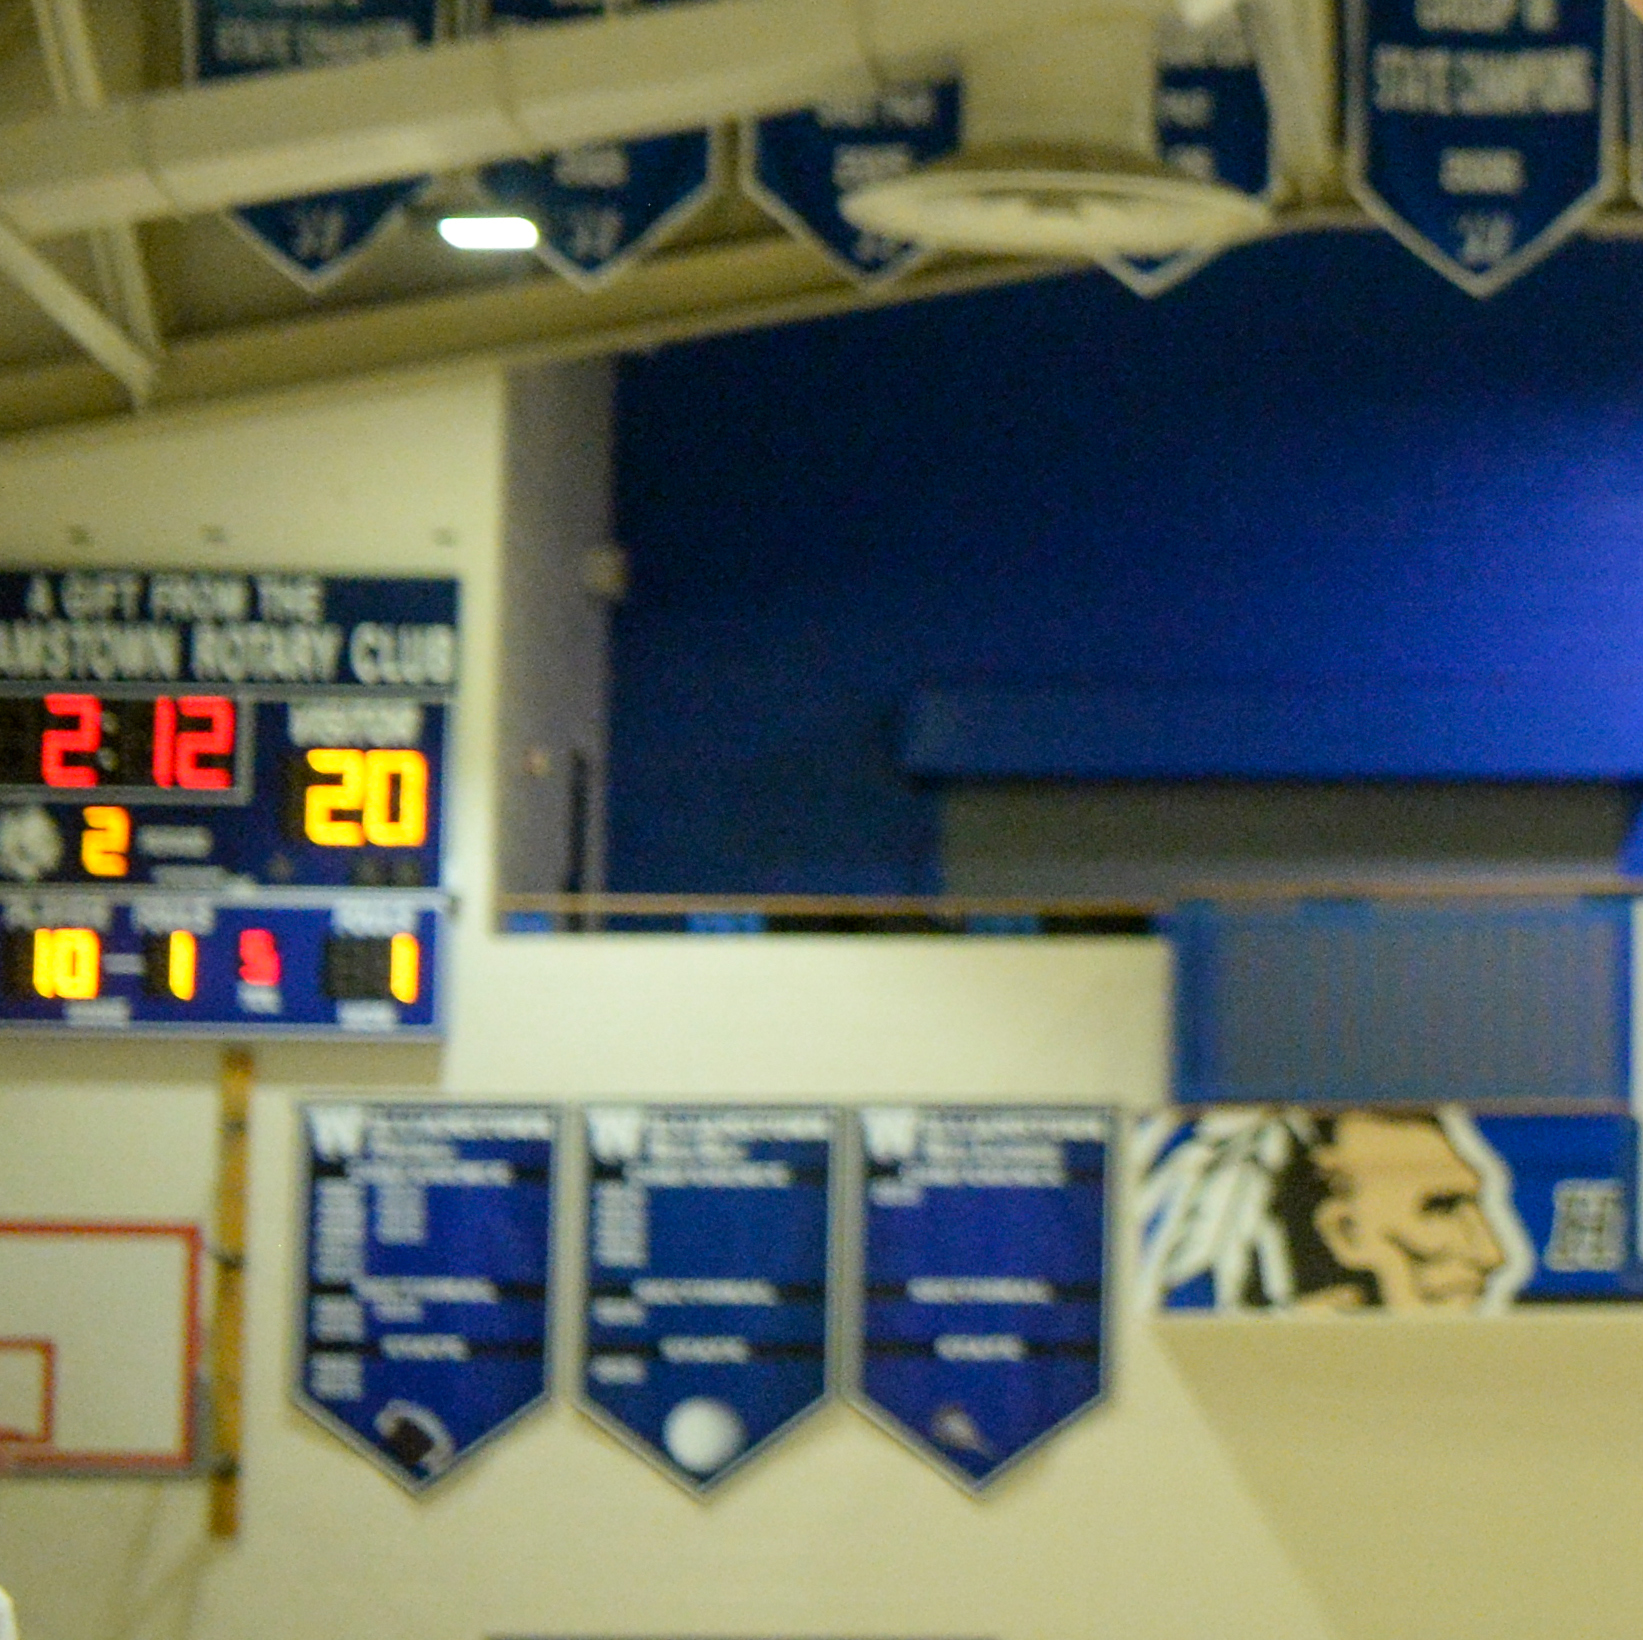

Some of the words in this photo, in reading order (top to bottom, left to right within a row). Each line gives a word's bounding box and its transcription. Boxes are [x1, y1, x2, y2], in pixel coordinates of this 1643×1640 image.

[190, 621, 344, 683] ROTARY
[350, 622, 456, 685] CLUB
[41, 693, 236, 790] 2:12
[303, 748, 428, 847] 20
[80, 806, 132, 878] 2
[168, 929, 197, 1002] 1
[389, 931, 420, 1004] 1
